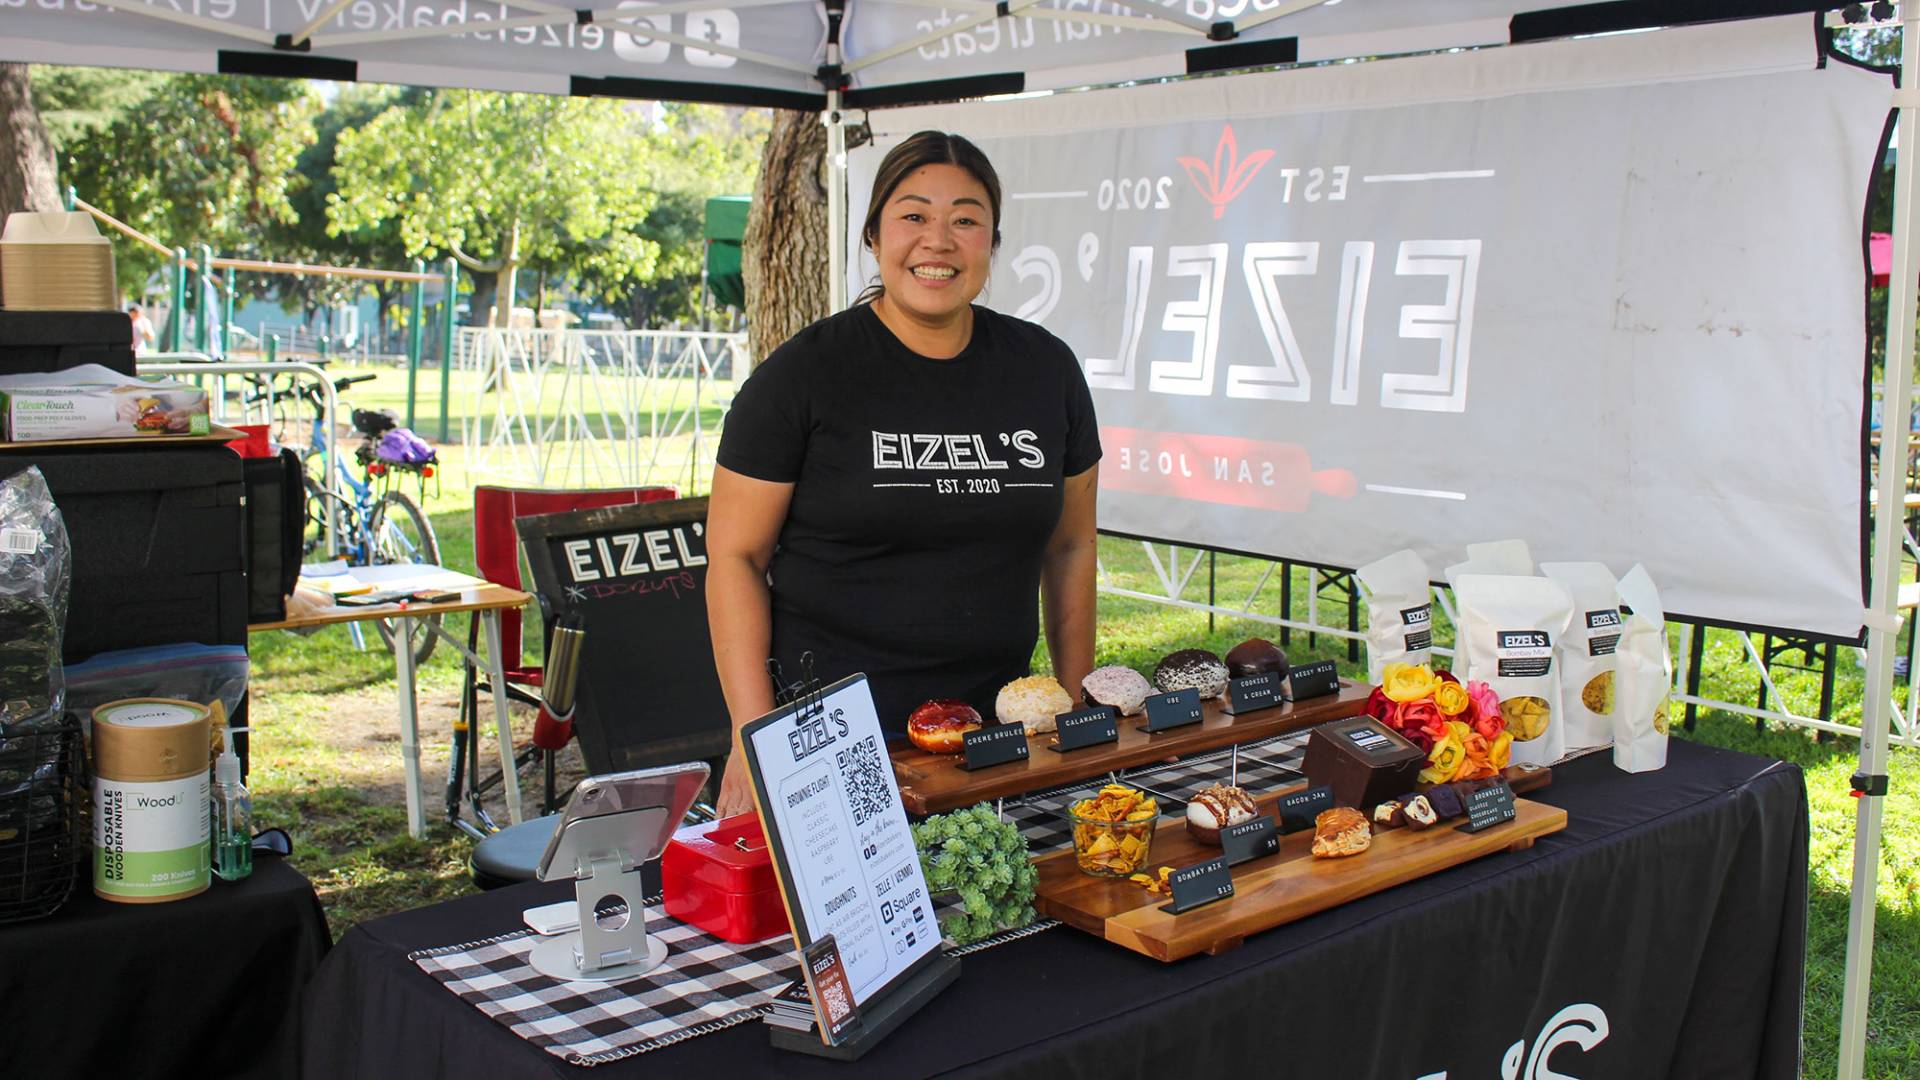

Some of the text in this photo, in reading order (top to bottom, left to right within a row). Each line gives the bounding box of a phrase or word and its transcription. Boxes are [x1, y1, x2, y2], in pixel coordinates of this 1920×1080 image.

[872, 429, 1045, 470] EIZEL'S
[936, 478, 1000, 494] EST. 2020
[563, 522, 708, 583] EIZEL'
[1504, 635, 1545, 647] EIZEL'S
[1240, 676, 1269, 688] COOKIES
[1294, 668, 1314, 680] MESSY
[1166, 696, 1180, 705] UBE
[1250, 689, 1272, 700] CREAM
[1065, 711, 1107, 728] CALAMANSI
[788, 709, 849, 762] EIZEL'S
[967, 728, 1024, 746] CREME BRULEE
[788, 776, 830, 808] BROWNIE FLIGHT
[1286, 791, 1327, 807] BACON JAM
[1474, 787, 1504, 801] BROWNIES
[103, 789, 115, 880] DISPOSABLE
[114, 791, 124, 881] WOODEN KNIVES
[1232, 822, 1264, 837] PUMPKIN
[1267, 839, 1277, 848] $6
[152, 872, 169, 882] 200
[876, 864, 913, 897] ZELLE VENMO
[1177, 861, 1222, 883] BOMBAY MIX
[1217, 884, 1233, 895] $13
[825, 886, 856, 915] DOUGHNUTS
[893, 887, 922, 914] Square
[813, 954, 836, 975] EIZEL'S
